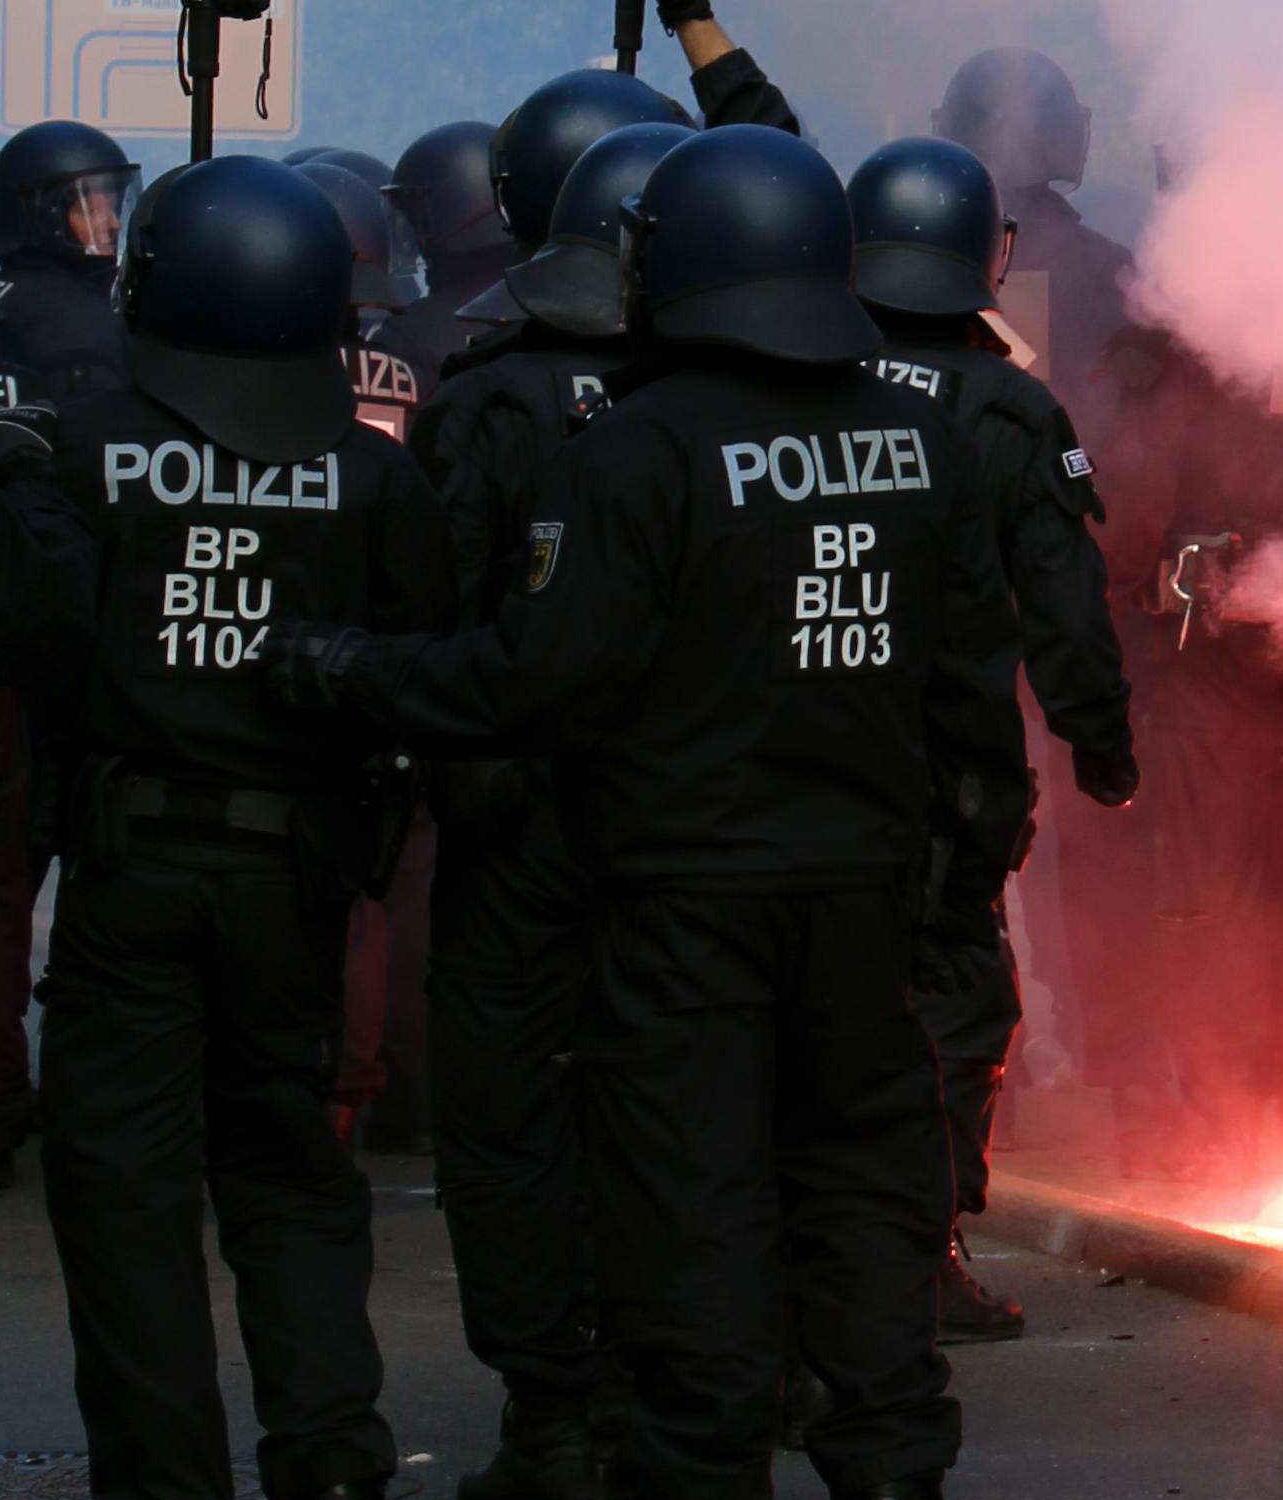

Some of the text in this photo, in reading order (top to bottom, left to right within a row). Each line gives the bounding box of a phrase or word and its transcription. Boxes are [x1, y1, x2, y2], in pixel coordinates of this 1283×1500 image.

[104, 439, 339, 510] POLIZEI
[721, 428, 932, 505] POLIZEI
[185, 526, 260, 570] BP
[813, 523, 876, 569] BP
[163, 574, 272, 620] BLU
[795, 571, 891, 620] BLU
[158, 622, 269, 669] 1104
[791, 622, 892, 669] 1103
